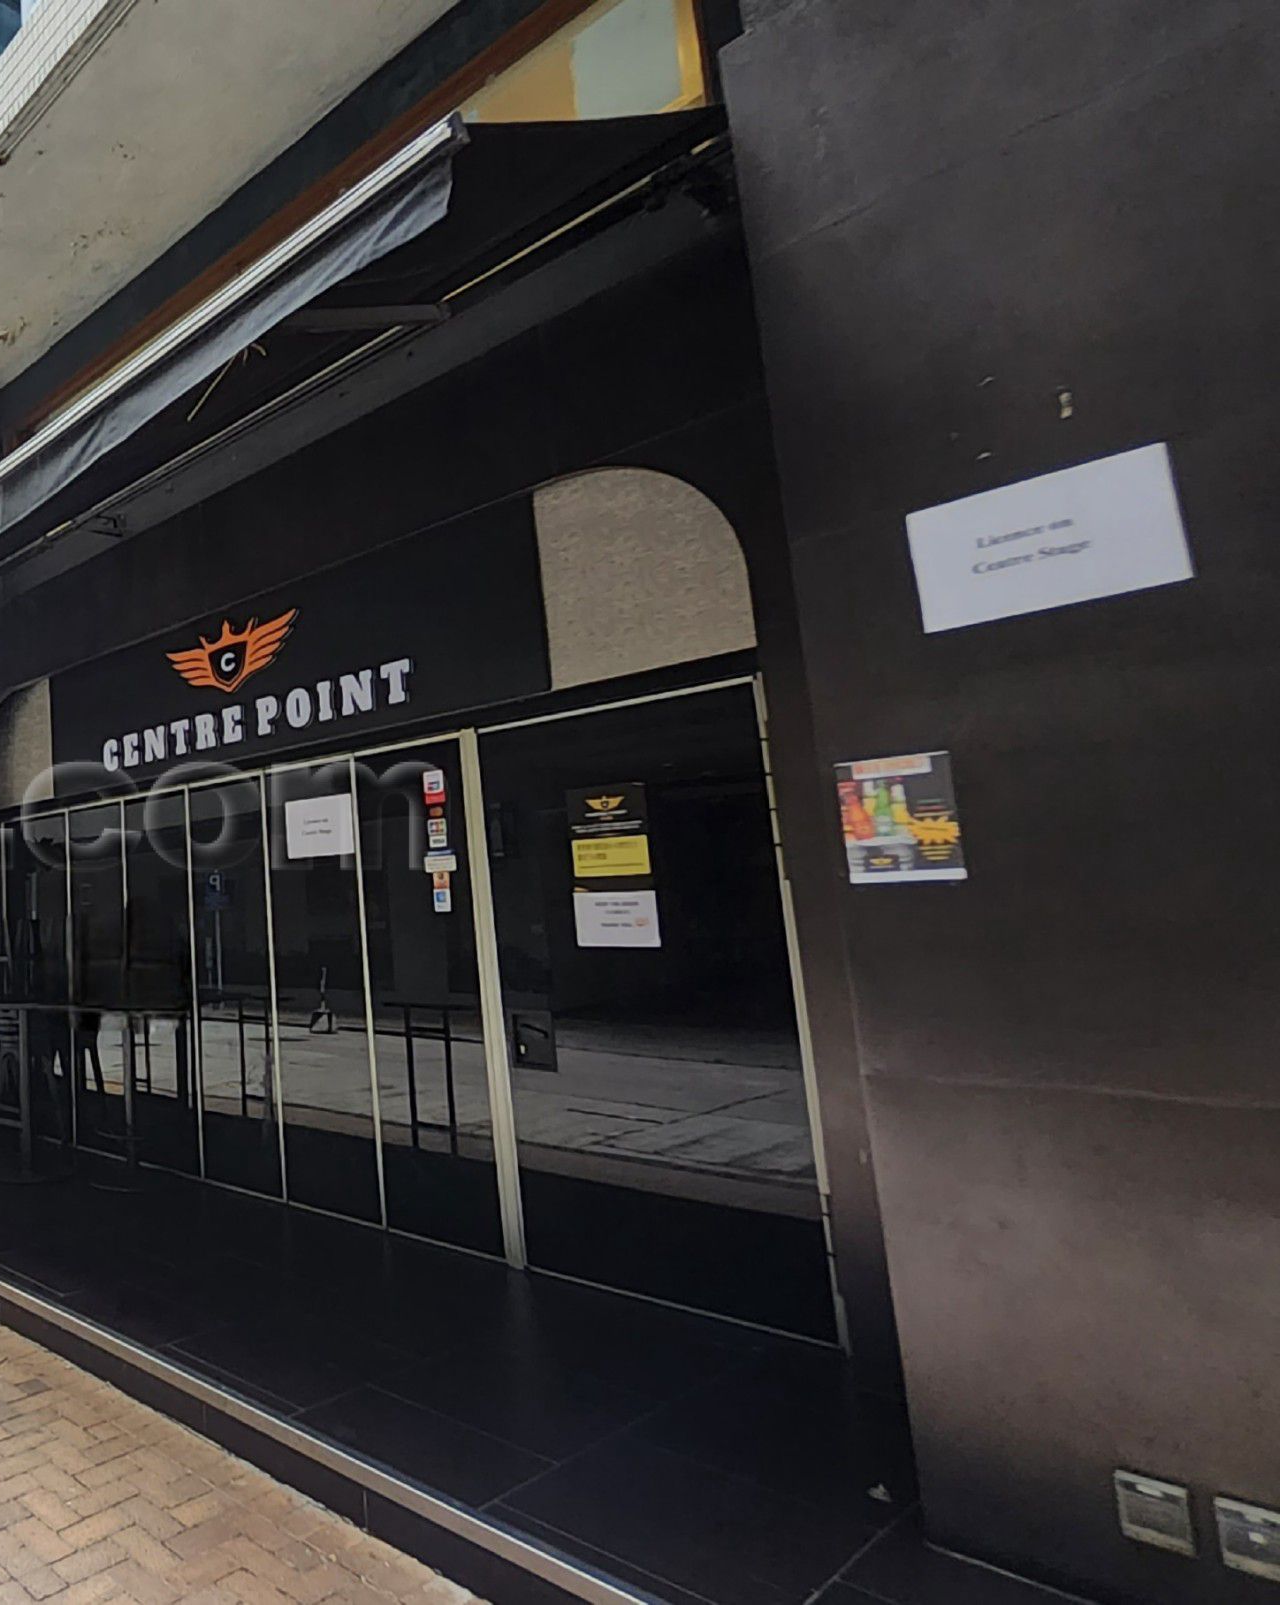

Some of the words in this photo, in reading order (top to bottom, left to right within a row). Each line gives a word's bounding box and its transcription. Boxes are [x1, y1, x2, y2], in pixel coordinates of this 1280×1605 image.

[220, 652, 236, 672] C
[103, 705, 243, 772] CENTRE
[256, 658, 411, 736] POINT
